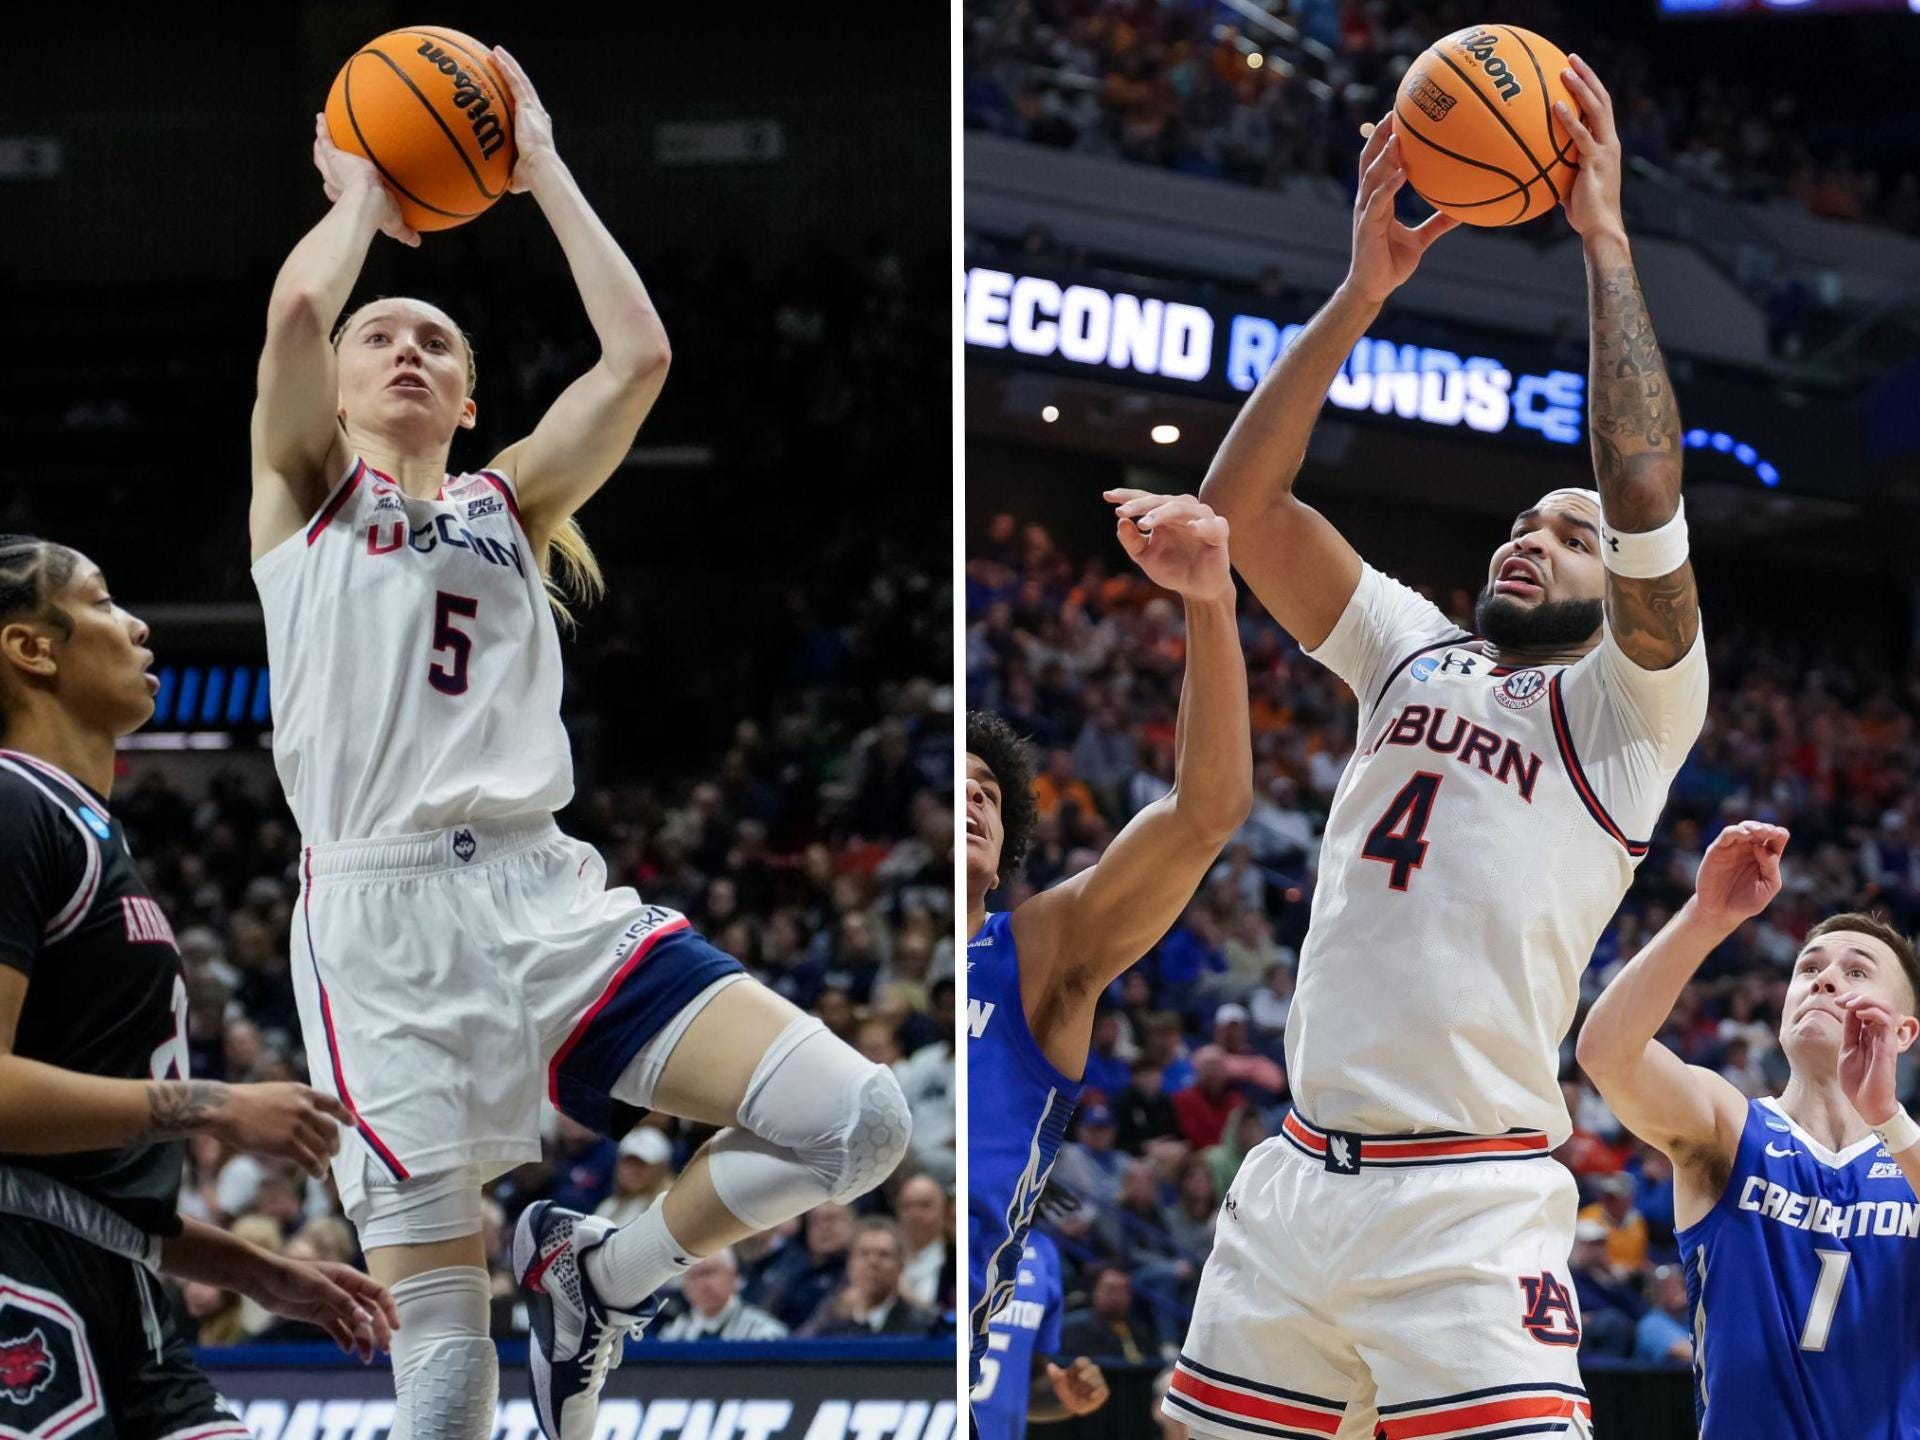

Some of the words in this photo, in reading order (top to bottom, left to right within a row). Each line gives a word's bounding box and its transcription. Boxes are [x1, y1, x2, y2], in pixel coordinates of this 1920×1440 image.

[417, 39, 505, 161] Wilson
[1455, 27, 1521, 102] ilson
[964, 267, 1214, 382] ECOND
[468, 496, 494, 509] BIG
[468, 503, 503, 517] EAST
[428, 589, 479, 696] 5
[1508, 672, 1540, 697] SEC
[1374, 705, 1543, 804] BURN
[1361, 770, 1443, 891] 4
[1738, 1175, 1920, 1239] CREIGHTON
[1798, 1248, 1851, 1352] 1
